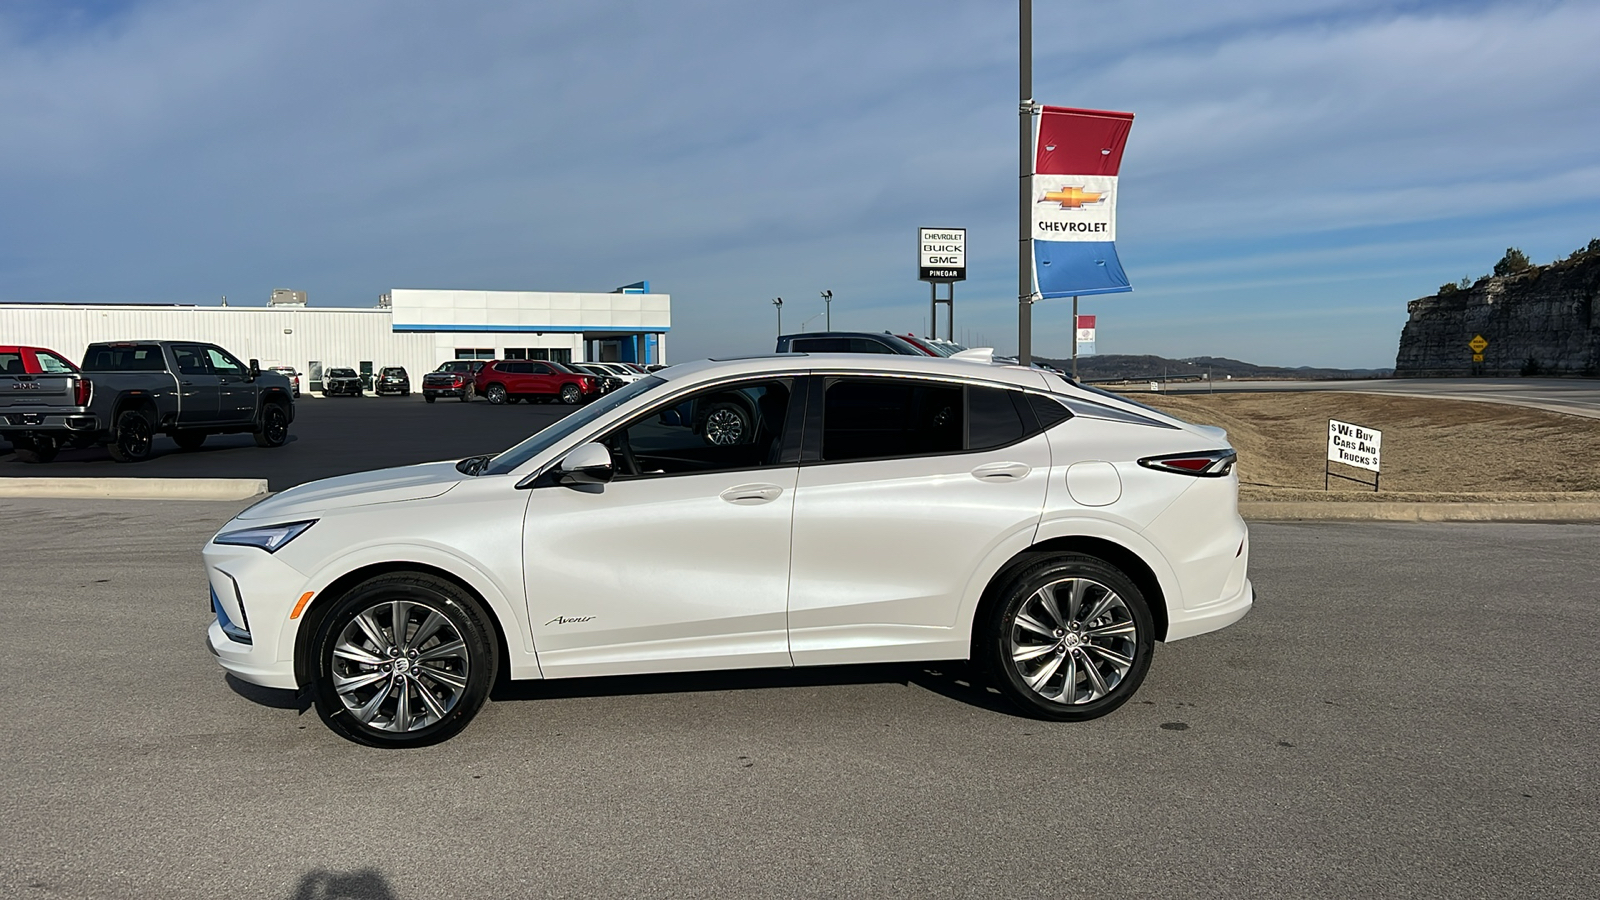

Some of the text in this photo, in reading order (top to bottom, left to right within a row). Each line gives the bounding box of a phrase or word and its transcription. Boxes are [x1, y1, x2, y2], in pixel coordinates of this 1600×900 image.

[1038, 221, 1108, 232] CHEVROLET
[923, 244, 963, 252] BUICK
[929, 256, 958, 264] GMC
